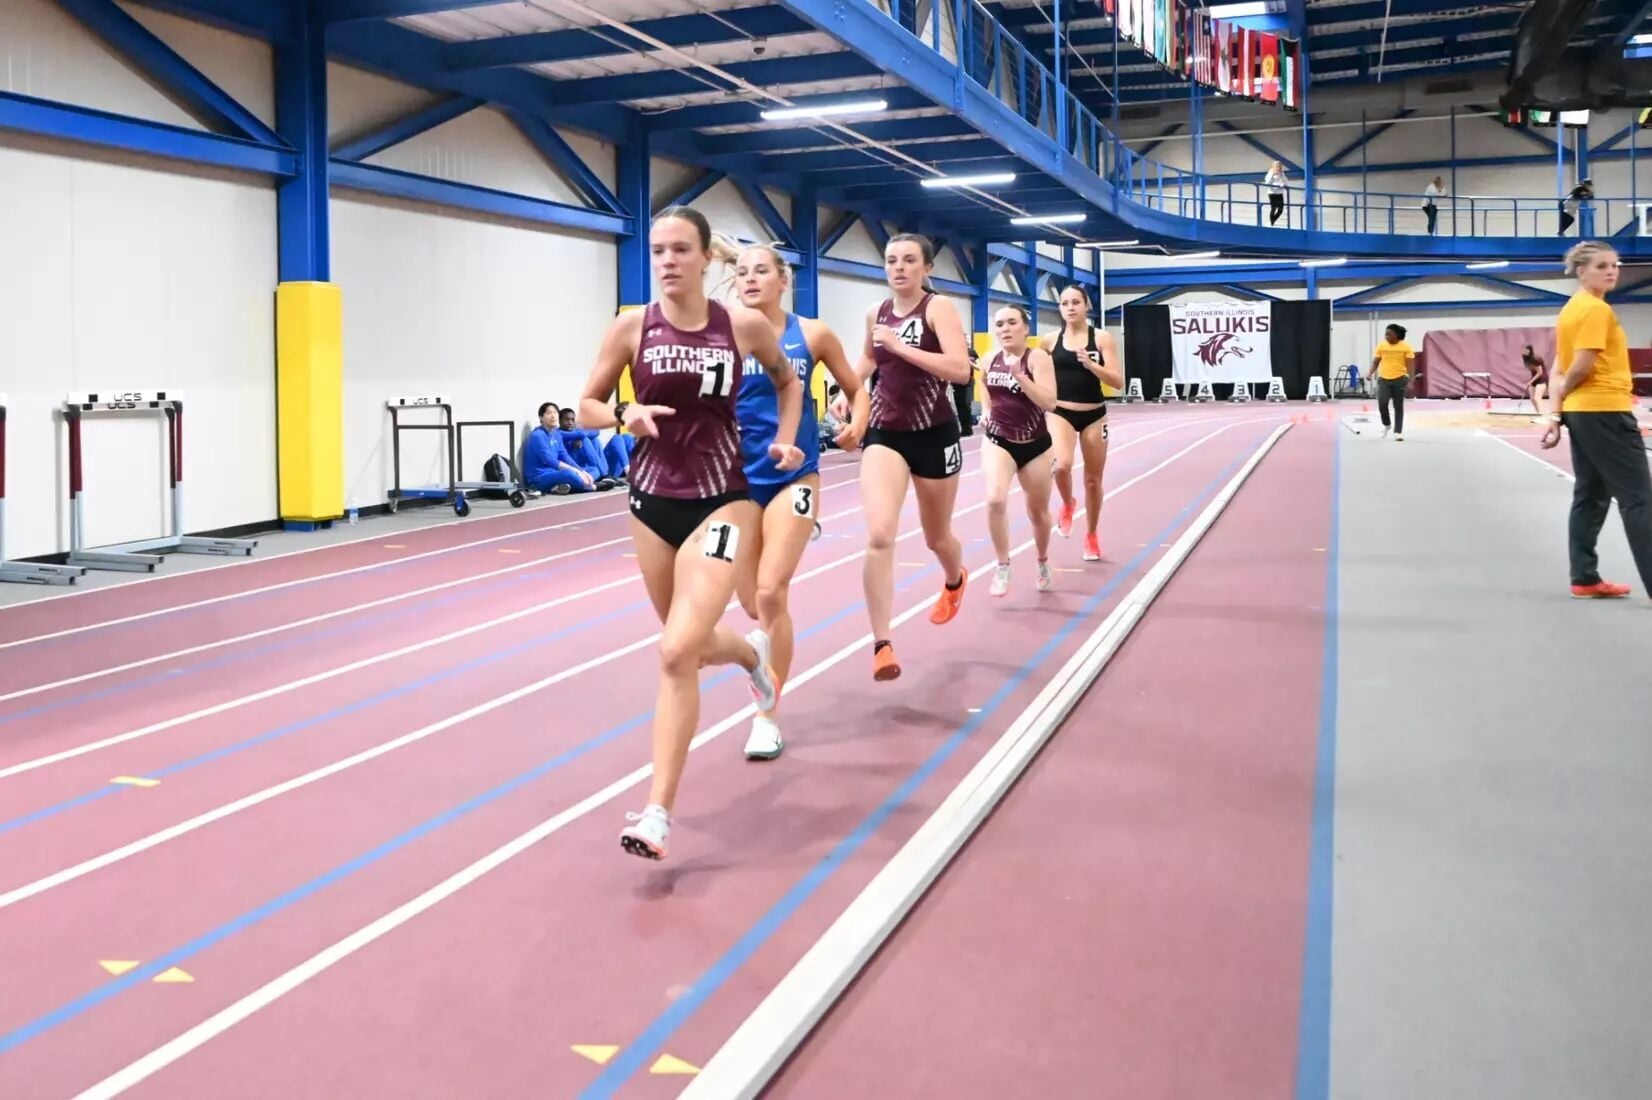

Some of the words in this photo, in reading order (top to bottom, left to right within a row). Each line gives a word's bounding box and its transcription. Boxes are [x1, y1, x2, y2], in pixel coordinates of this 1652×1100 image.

[901, 319, 919, 345] 4
[1172, 316, 1269, 334] SALUKIS
[643, 344, 735, 364] SOUTHERN
[652, 357, 705, 375] ILLINO
[701, 361, 729, 398] 1
[113, 392, 142, 402] UCS
[1130, 385, 1139, 396] 6
[1164, 385, 1173, 396] 5
[1200, 385, 1210, 395] 4
[1237, 384, 1245, 395] 3
[1272, 383, 1281, 395] 2
[107, 402, 136, 410] UCS
[1102, 424, 1109, 440] 5
[946, 445, 960, 472] 4
[794, 487, 812, 515] 3
[705, 524, 733, 563] 1
